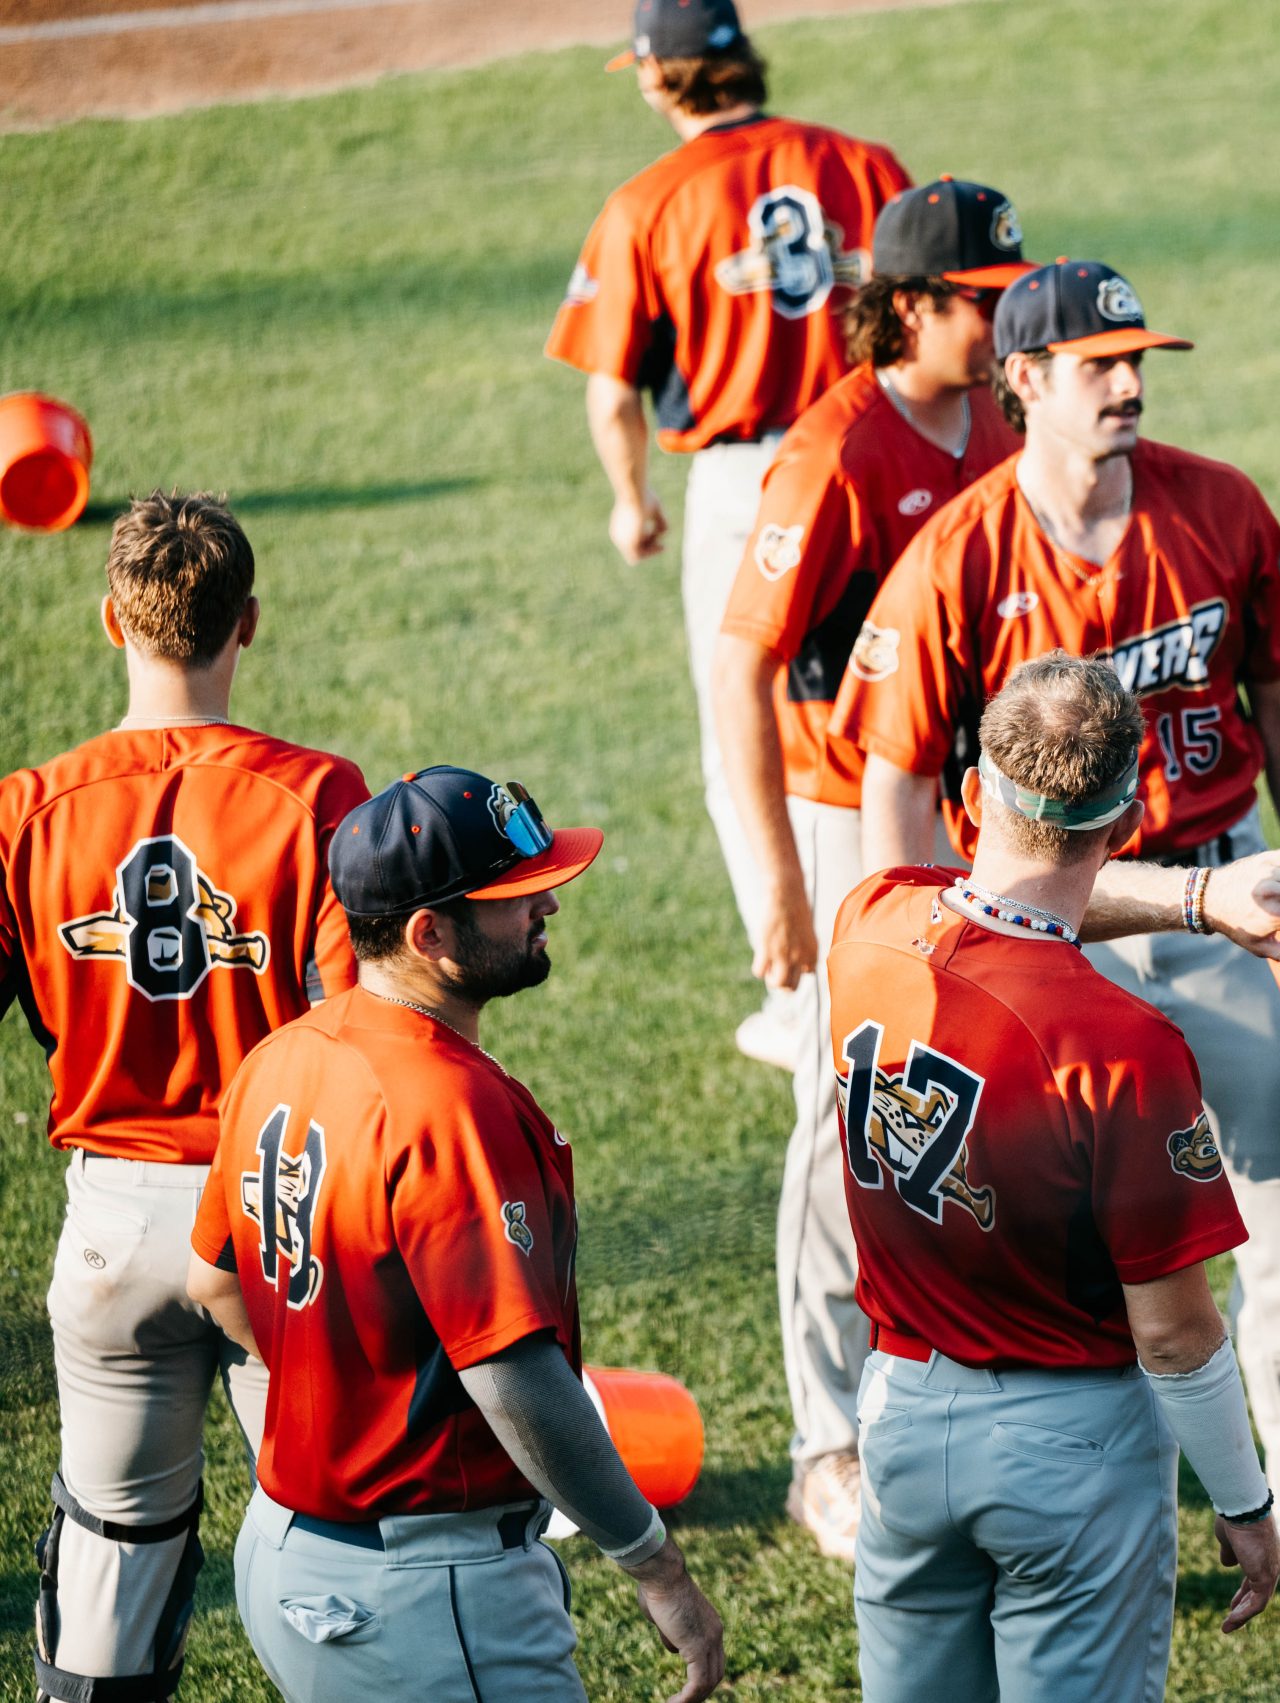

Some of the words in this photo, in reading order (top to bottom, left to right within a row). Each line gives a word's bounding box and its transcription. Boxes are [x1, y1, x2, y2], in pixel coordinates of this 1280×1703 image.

[747, 184, 834, 320] 3
[1106, 604, 1225, 693] VERS
[1156, 704, 1222, 782] 15
[116, 833, 213, 1003] 8
[842, 1018, 986, 1226] 17
